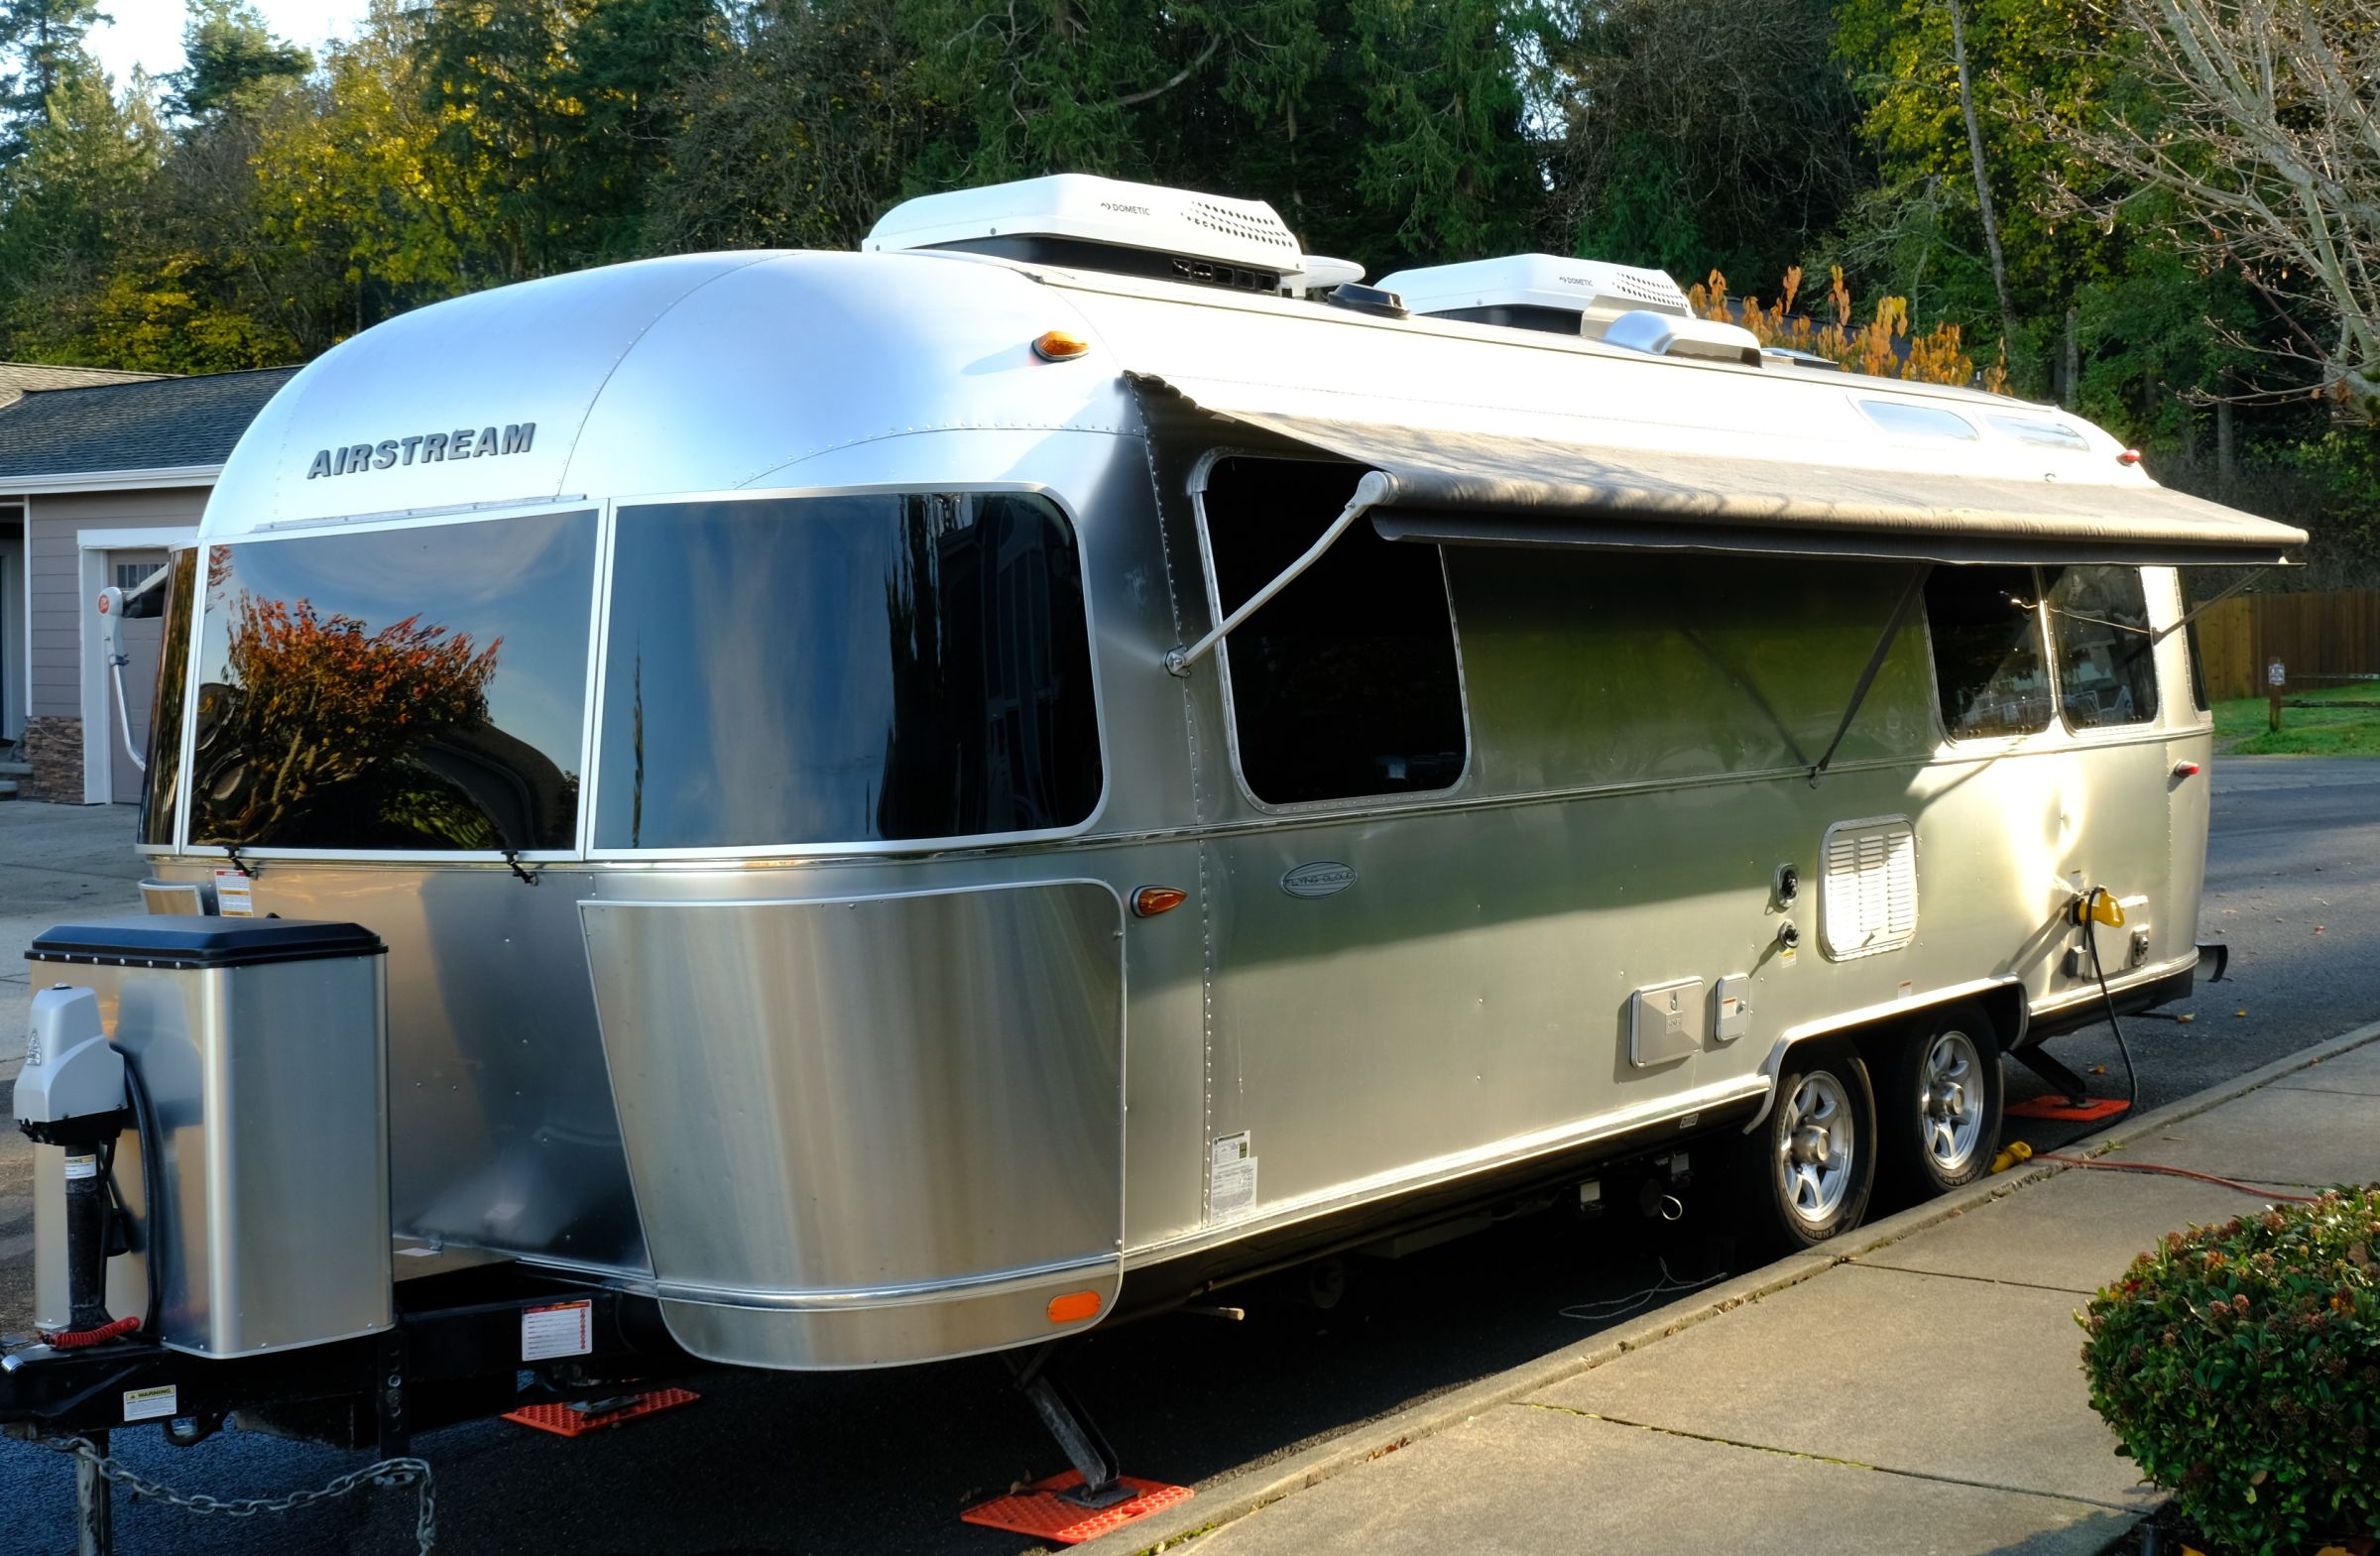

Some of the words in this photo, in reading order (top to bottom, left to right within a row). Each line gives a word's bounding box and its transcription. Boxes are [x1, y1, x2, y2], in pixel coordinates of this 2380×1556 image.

[1112, 202, 1150, 216] DOMETIC
[1567, 277, 1594, 287] DOMETIC
[306, 421, 536, 480] AIRSTREAM
[1284, 875, 1319, 887] FLYING
[1322, 872, 1354, 883] CLOUD
[138, 1387, 172, 1398] WARNING
